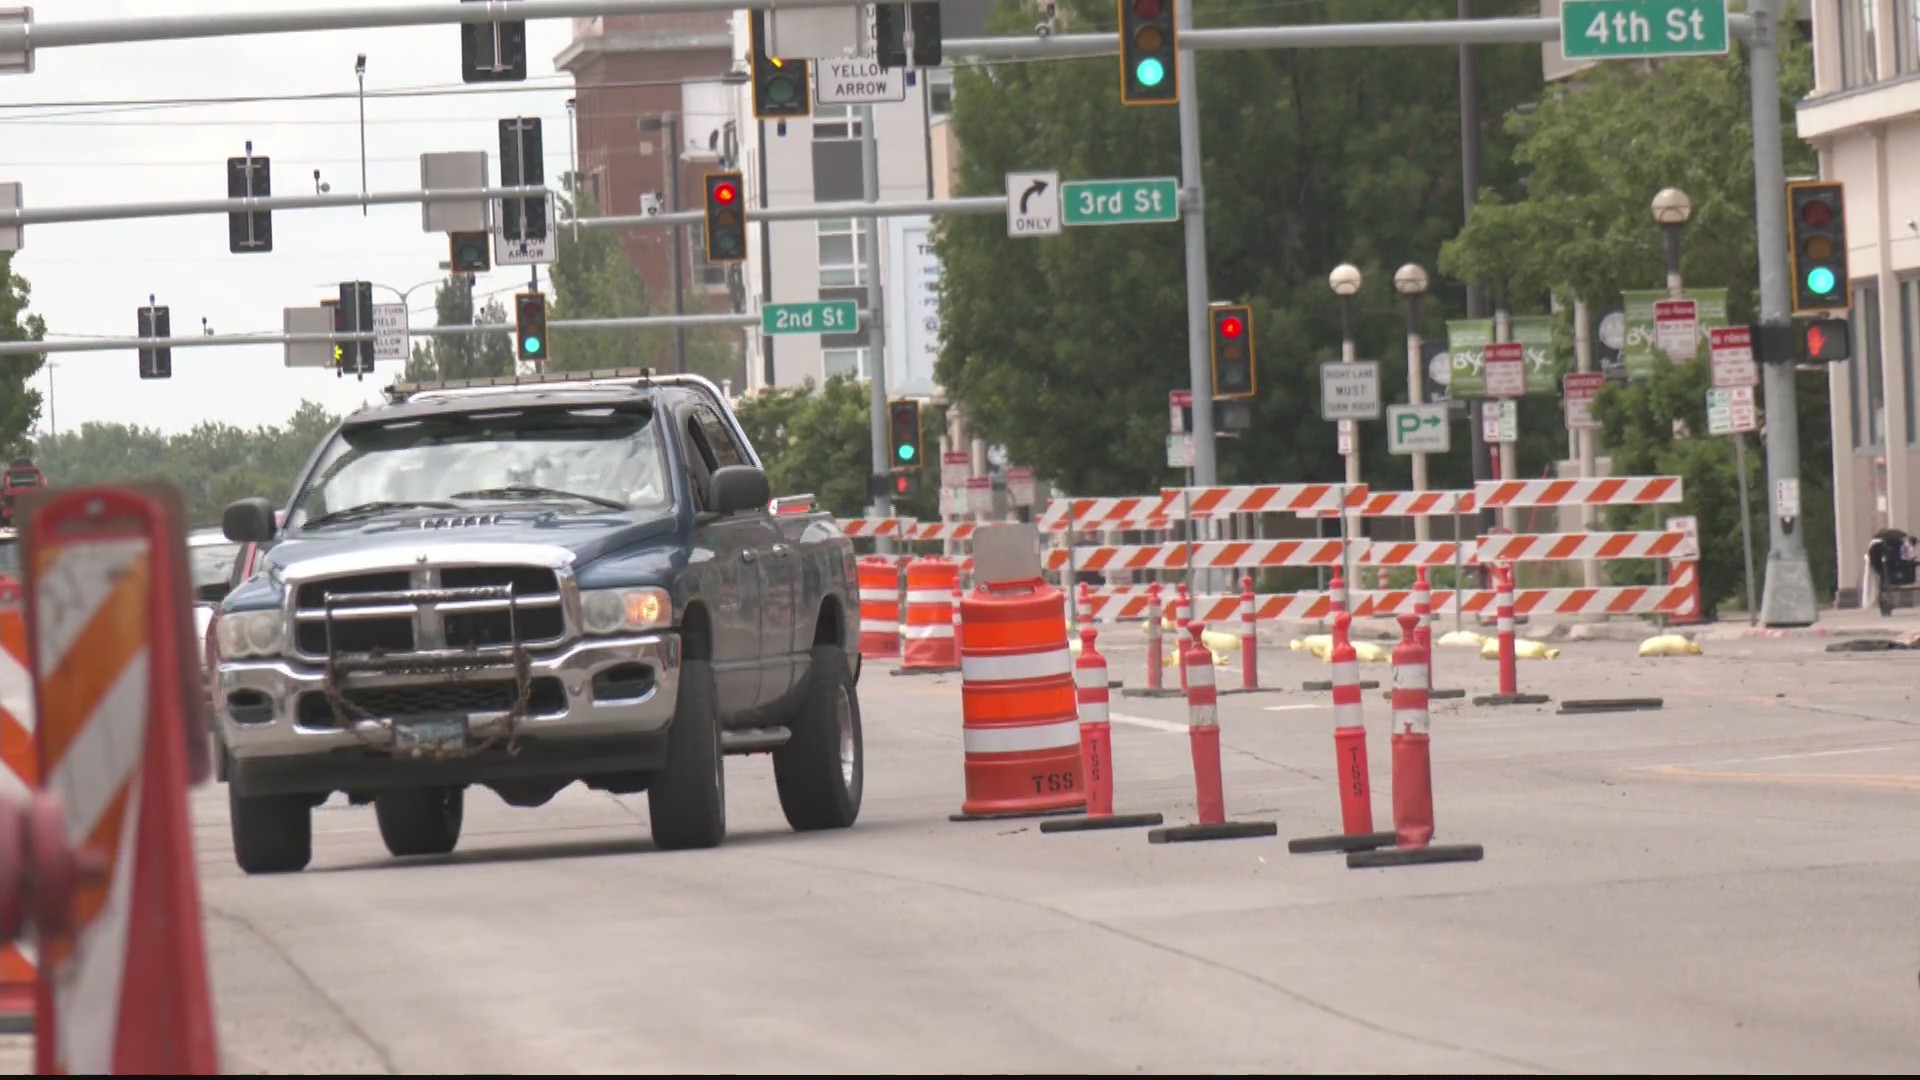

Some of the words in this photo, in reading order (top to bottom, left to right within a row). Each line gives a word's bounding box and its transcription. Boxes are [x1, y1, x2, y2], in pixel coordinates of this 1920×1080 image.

[1585, 10, 1649, 44] 4th
[1666, 7, 1705, 42] St
[831, 63, 889, 78] YELLOW
[835, 81, 887, 96] ARROW
[1079, 190, 1122, 215] 3rd
[1134, 188, 1162, 213] St
[1016, 218, 1051, 230] ONLY
[508, 248, 543, 259] AROW
[776, 308, 813, 329] 2nd
[822, 306, 844, 326] St
[1336, 384, 1366, 396] MUST
[1327, 402, 1348, 411] TURN
[1352, 402, 1375, 411] RIGHT
[1350, 747, 1362, 797] TSS
[1032, 771, 1074, 794] TSS
